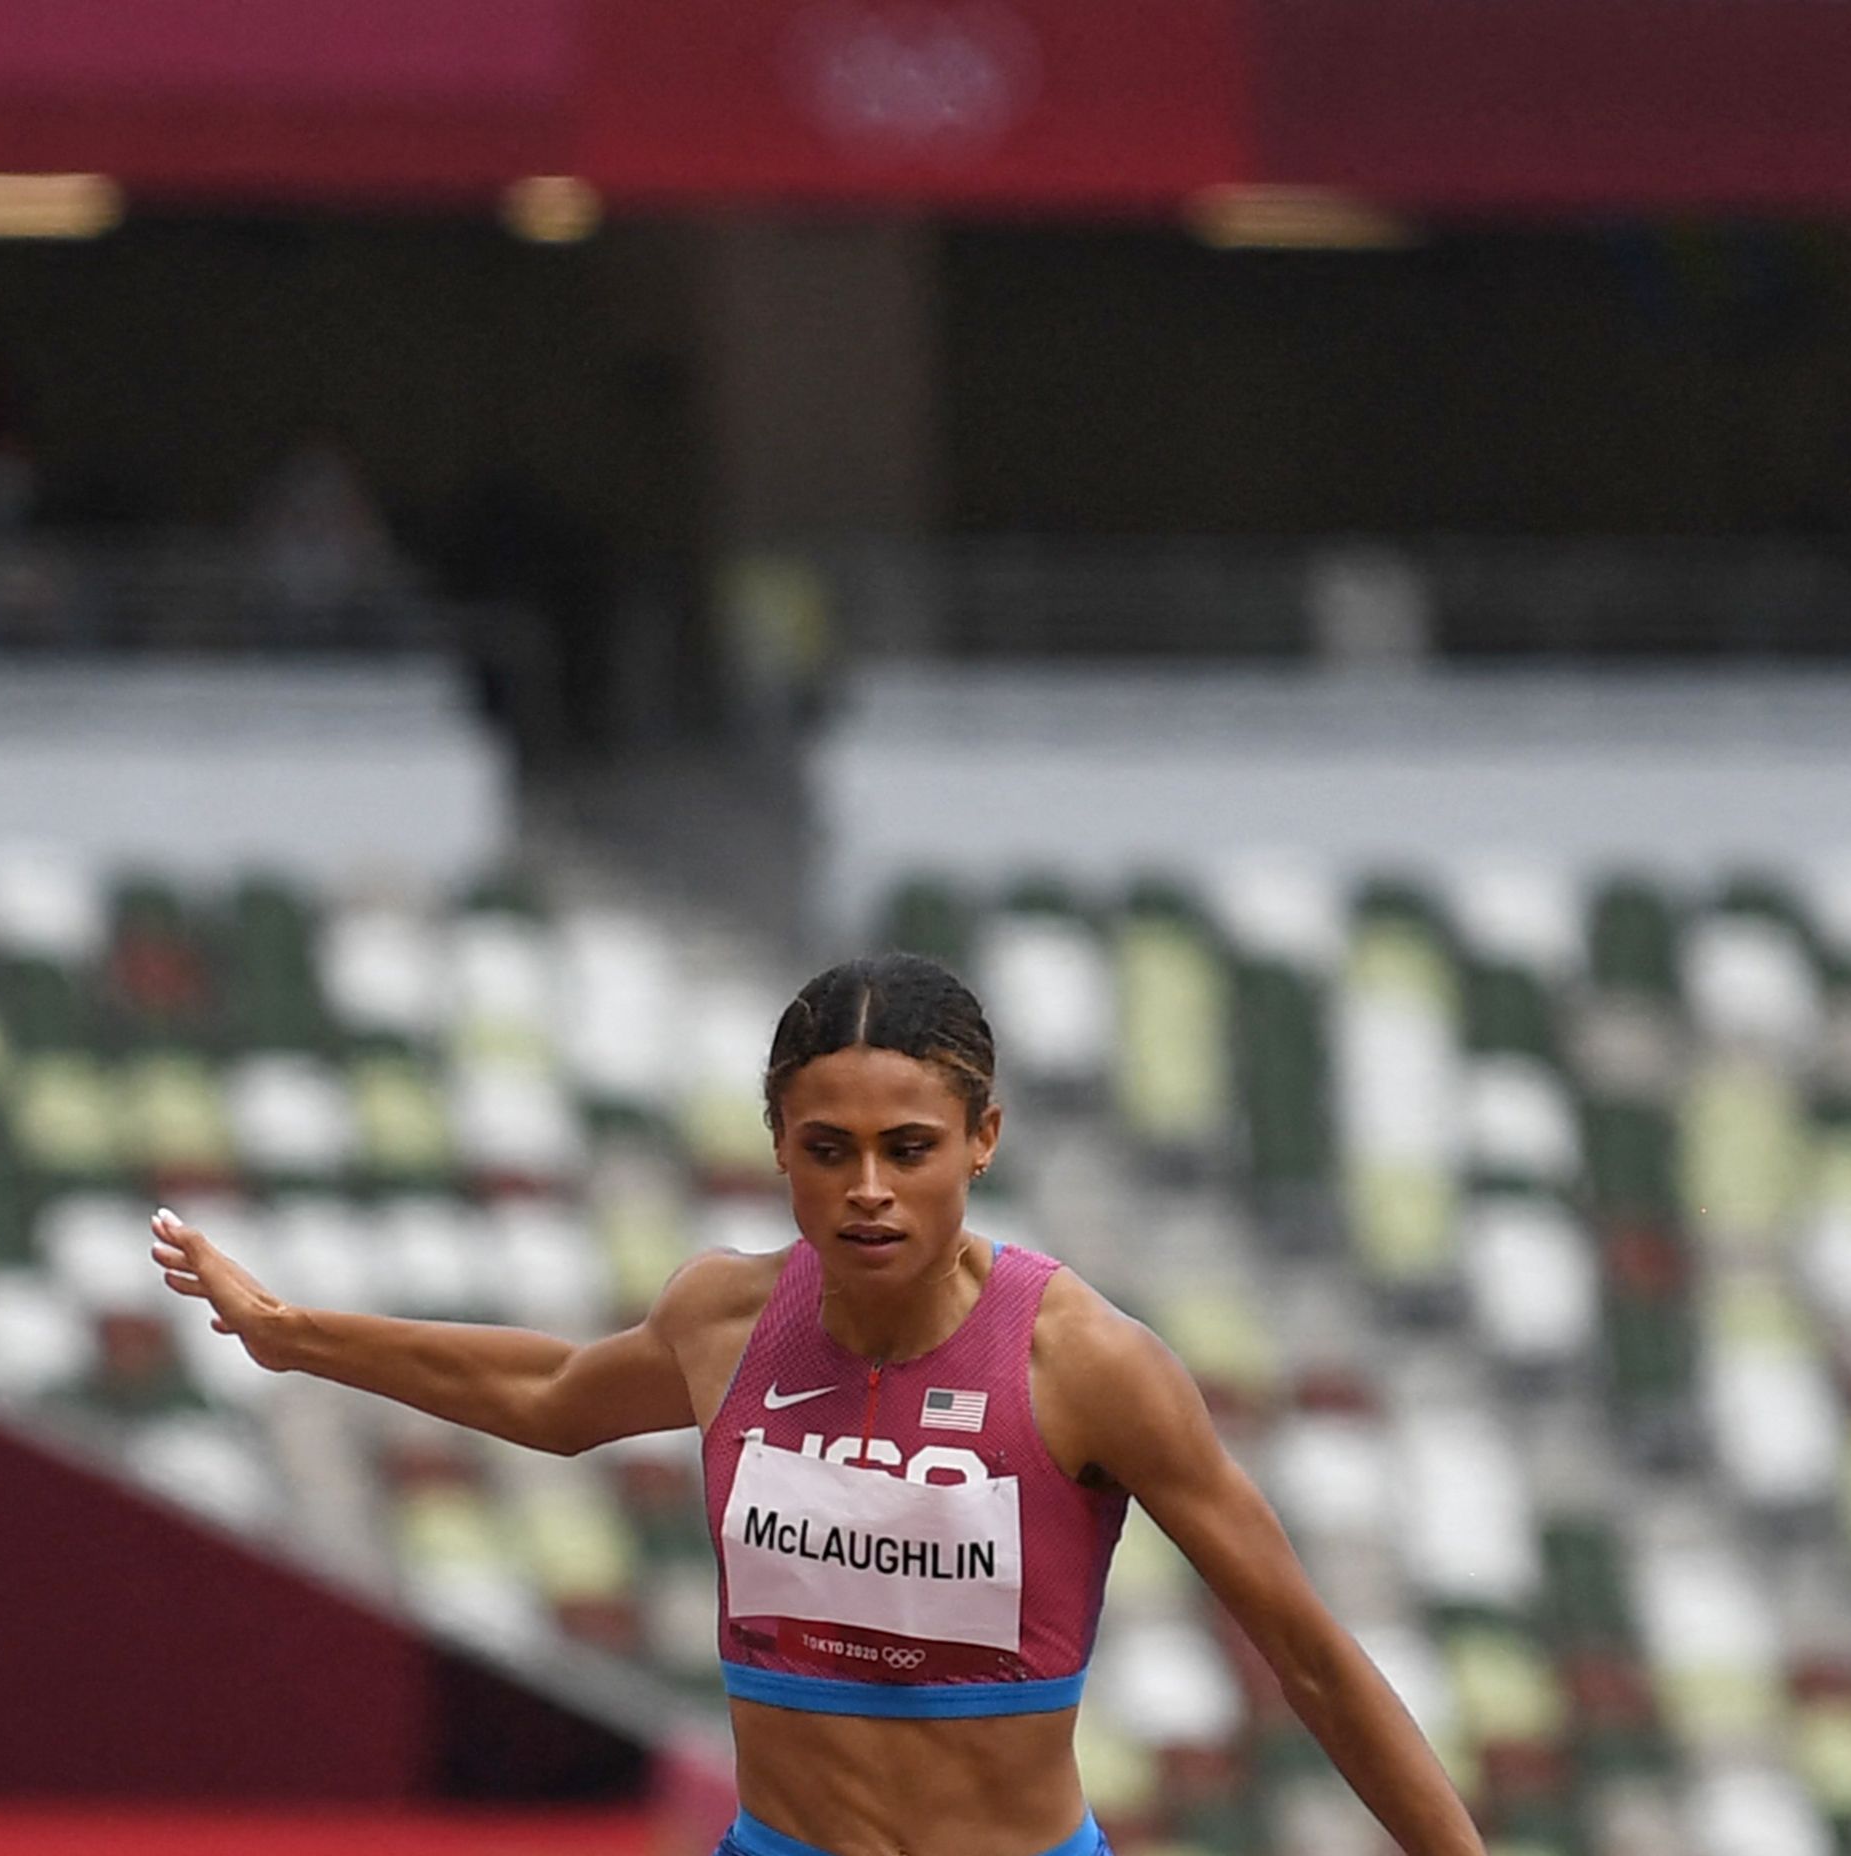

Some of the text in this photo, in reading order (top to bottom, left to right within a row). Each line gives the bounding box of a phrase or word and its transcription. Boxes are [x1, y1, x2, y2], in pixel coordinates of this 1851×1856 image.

[743, 1506, 995, 1580] McLAUGHLIN
[802, 1632, 879, 1662] TOKYO 2020
